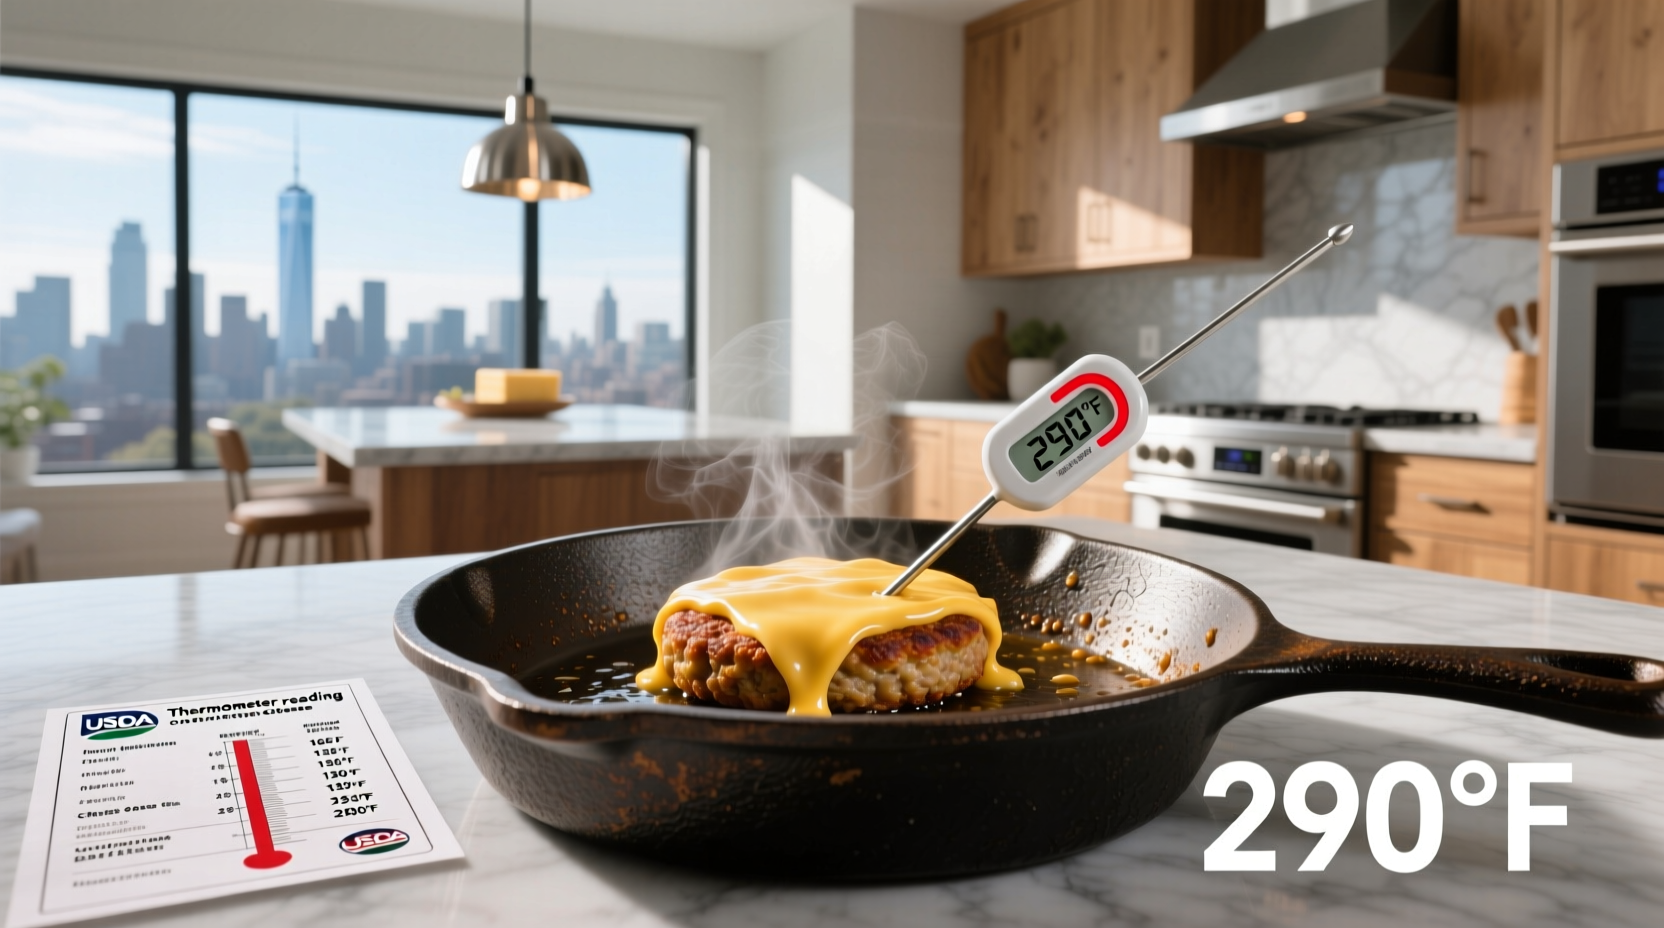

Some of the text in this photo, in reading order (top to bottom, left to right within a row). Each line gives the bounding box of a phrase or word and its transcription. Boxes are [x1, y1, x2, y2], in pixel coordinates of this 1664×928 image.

[1026, 395, 1101, 471] 290°F
[167, 698, 278, 718] Thermometer
[282, 692, 343, 706] reading
